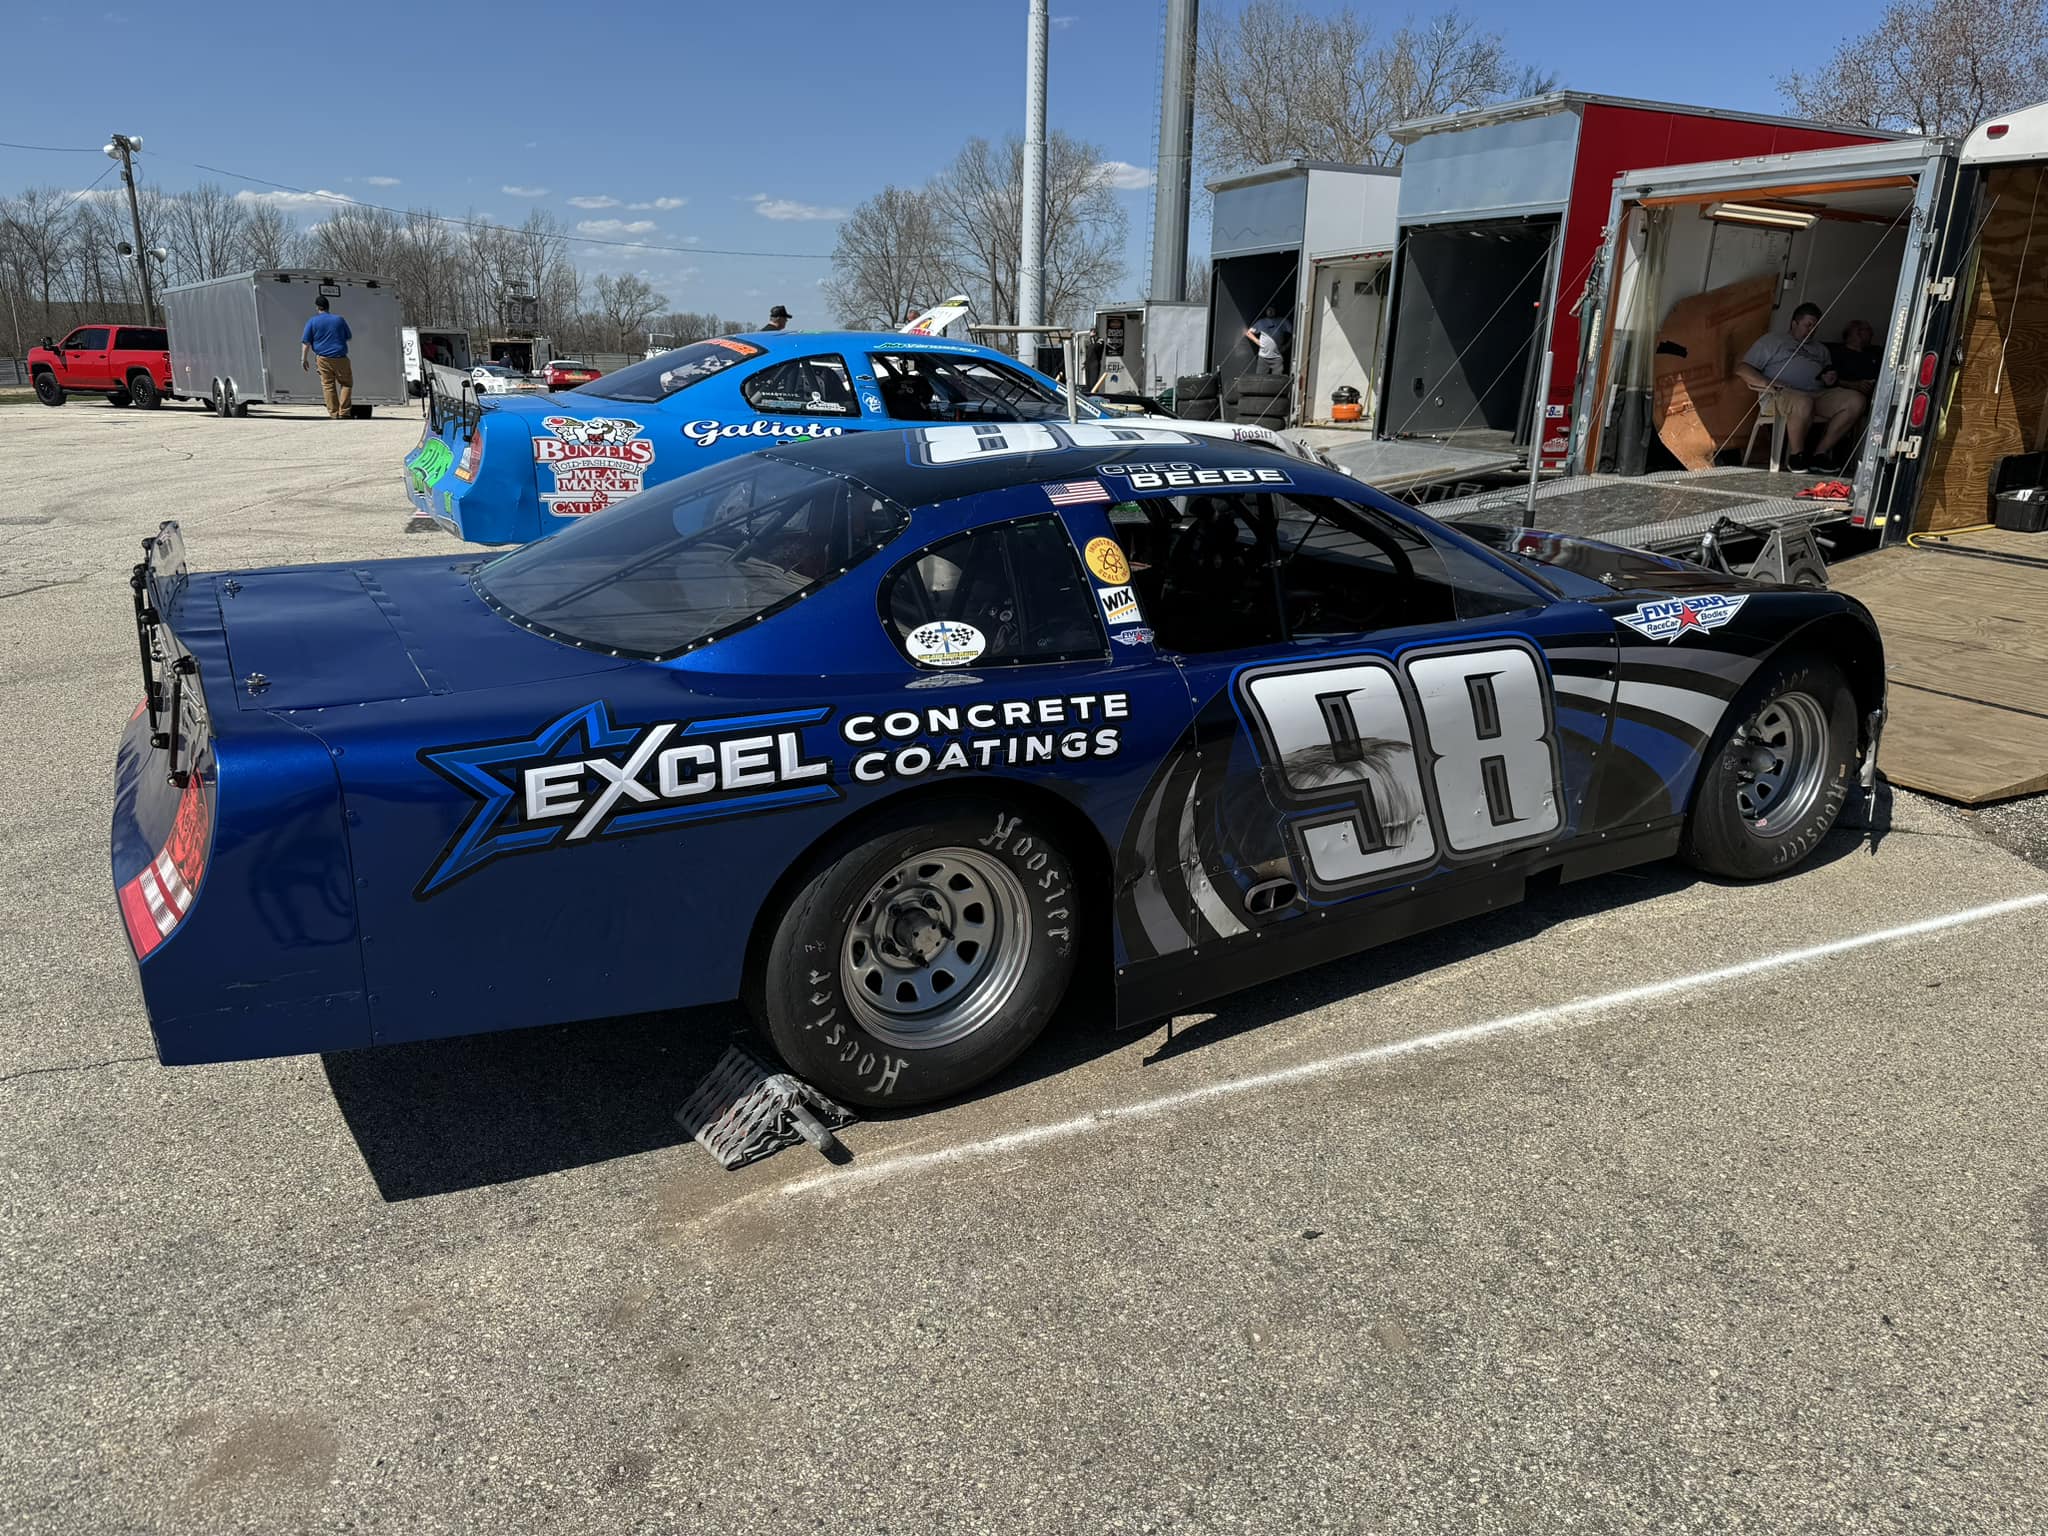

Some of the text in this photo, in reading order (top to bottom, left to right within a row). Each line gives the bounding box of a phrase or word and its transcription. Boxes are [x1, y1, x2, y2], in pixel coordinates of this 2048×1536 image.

[683, 420, 842, 446] Galioto
[573, 469, 625, 480] MEAT
[1102, 463, 1193, 475] GREG
[1130, 469, 1285, 488] BEEBE
[560, 479, 639, 491] MARKET
[593, 490, 607, 503] &
[1102, 588, 1134, 611] WIX
[1641, 595, 1726, 622] FIVE STAR
[1647, 609, 1728, 632] RaceCar Bodies
[843, 693, 1129, 743] CONCRETE
[849, 728, 1120, 783] COATINGS
[1243, 642, 1562, 888] 98
[523, 723, 828, 841] EXCEL
[978, 812, 1071, 942] Hoosier
[808, 969, 910, 1096] Hoosier
